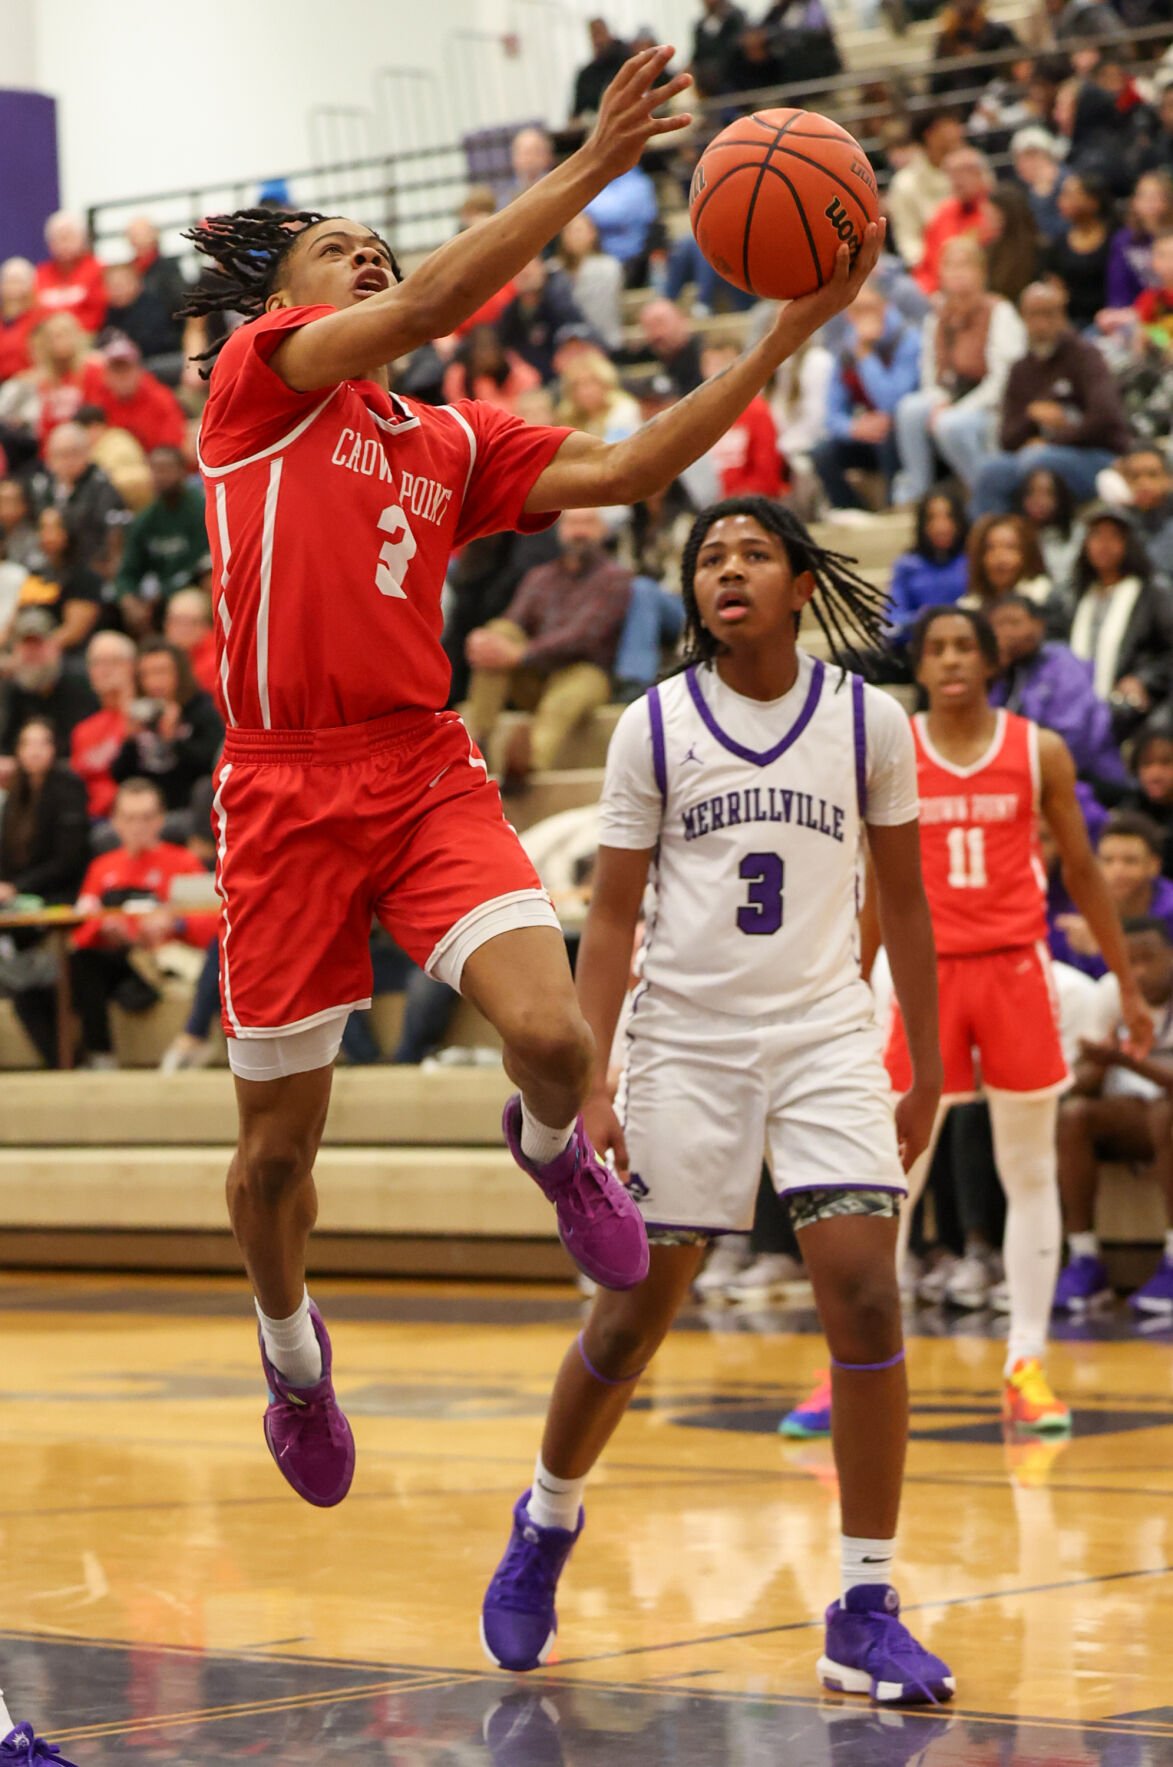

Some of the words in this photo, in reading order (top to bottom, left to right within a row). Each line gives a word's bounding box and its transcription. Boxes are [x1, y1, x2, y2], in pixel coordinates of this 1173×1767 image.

[399, 470, 453, 526] POINT
[375, 504, 417, 600] 3
[681, 787, 845, 842] MERRILLVILLE
[947, 827, 987, 889] 11
[736, 852, 784, 935] 3
